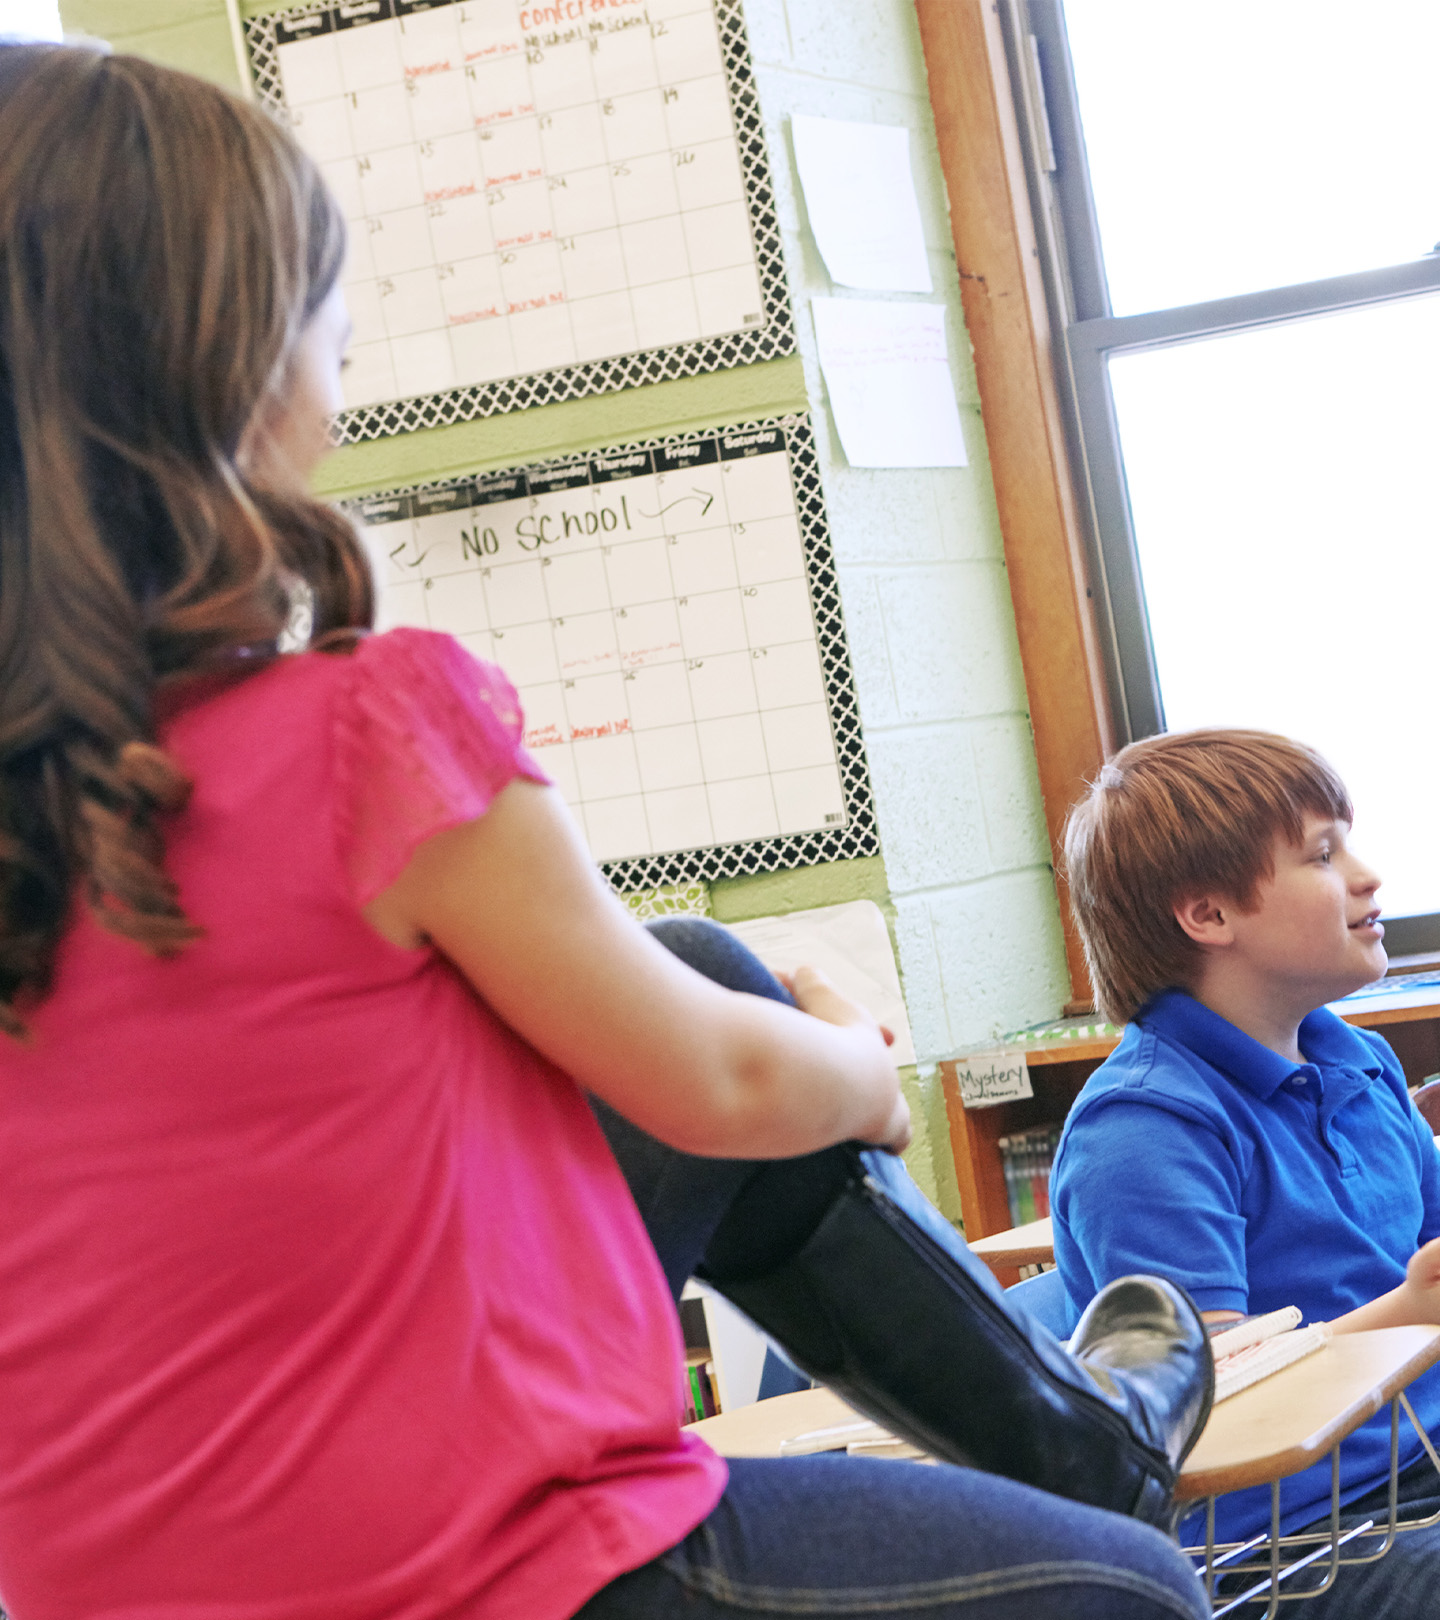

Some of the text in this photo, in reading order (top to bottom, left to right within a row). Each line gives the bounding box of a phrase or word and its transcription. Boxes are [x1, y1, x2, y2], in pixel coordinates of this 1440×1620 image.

[651, 21, 669, 39] 12
[663, 87, 679, 104] 19
[673, 150, 695, 166] 26
[613, 161, 631, 177] 25
[594, 453, 646, 472] Thursday
[664, 443, 701, 460] Friday
[723, 430, 777, 449] Saturday
[960, 1064, 1023, 1098] Mystery
